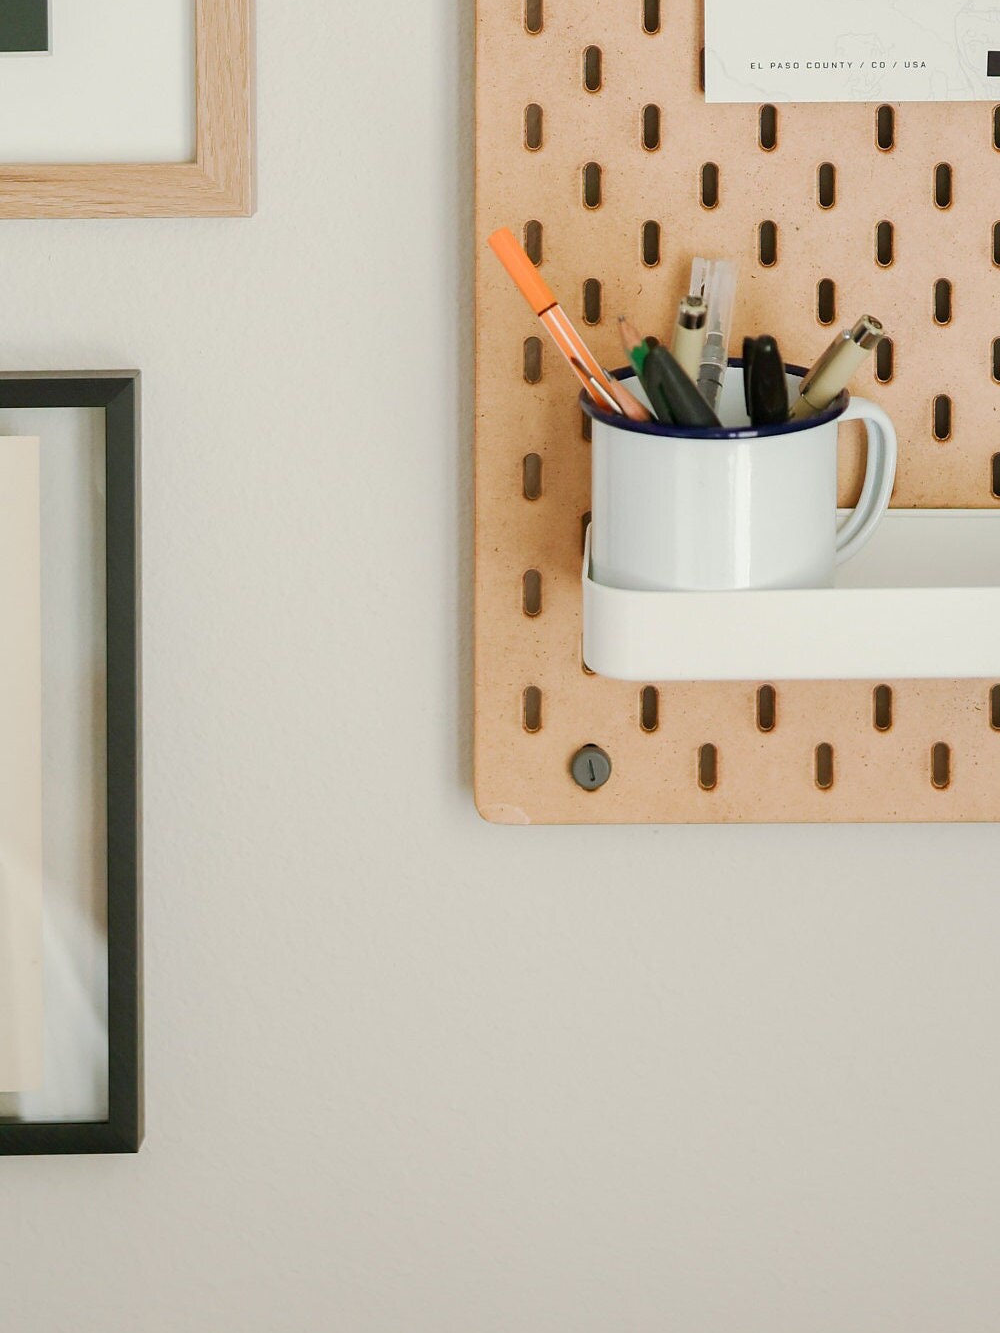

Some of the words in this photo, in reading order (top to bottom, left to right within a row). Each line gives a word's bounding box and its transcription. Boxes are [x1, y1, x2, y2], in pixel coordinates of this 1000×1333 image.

[750, 62, 763, 70] EL
[806, 61, 853, 69] COUNTY
[871, 61, 886, 69] CO
[904, 61, 927, 69] USA
